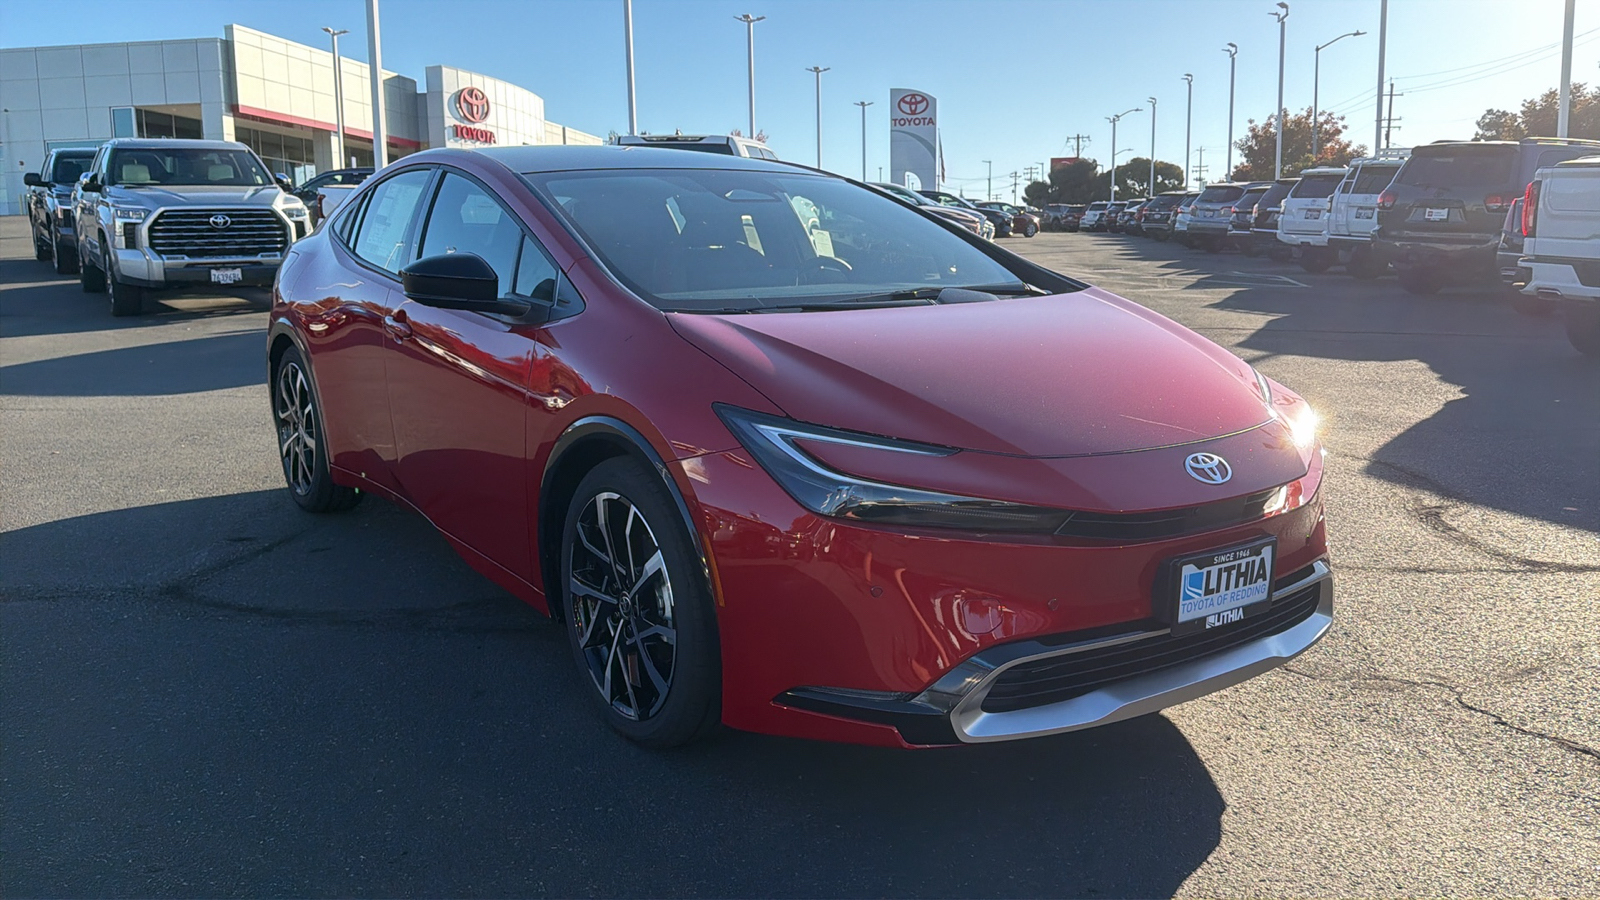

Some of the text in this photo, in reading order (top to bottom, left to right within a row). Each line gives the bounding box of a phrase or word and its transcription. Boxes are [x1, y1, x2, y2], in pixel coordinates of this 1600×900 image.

[892, 117, 934, 126] TOYOTA
[454, 124, 496, 143] TOYOTA
[1213, 552, 1235, 564] SINCE
[1204, 557, 1266, 596] LITHIA
[1181, 583, 1267, 614] TOYOTA OF REDDING
[1214, 607, 1244, 627] LITHIA
